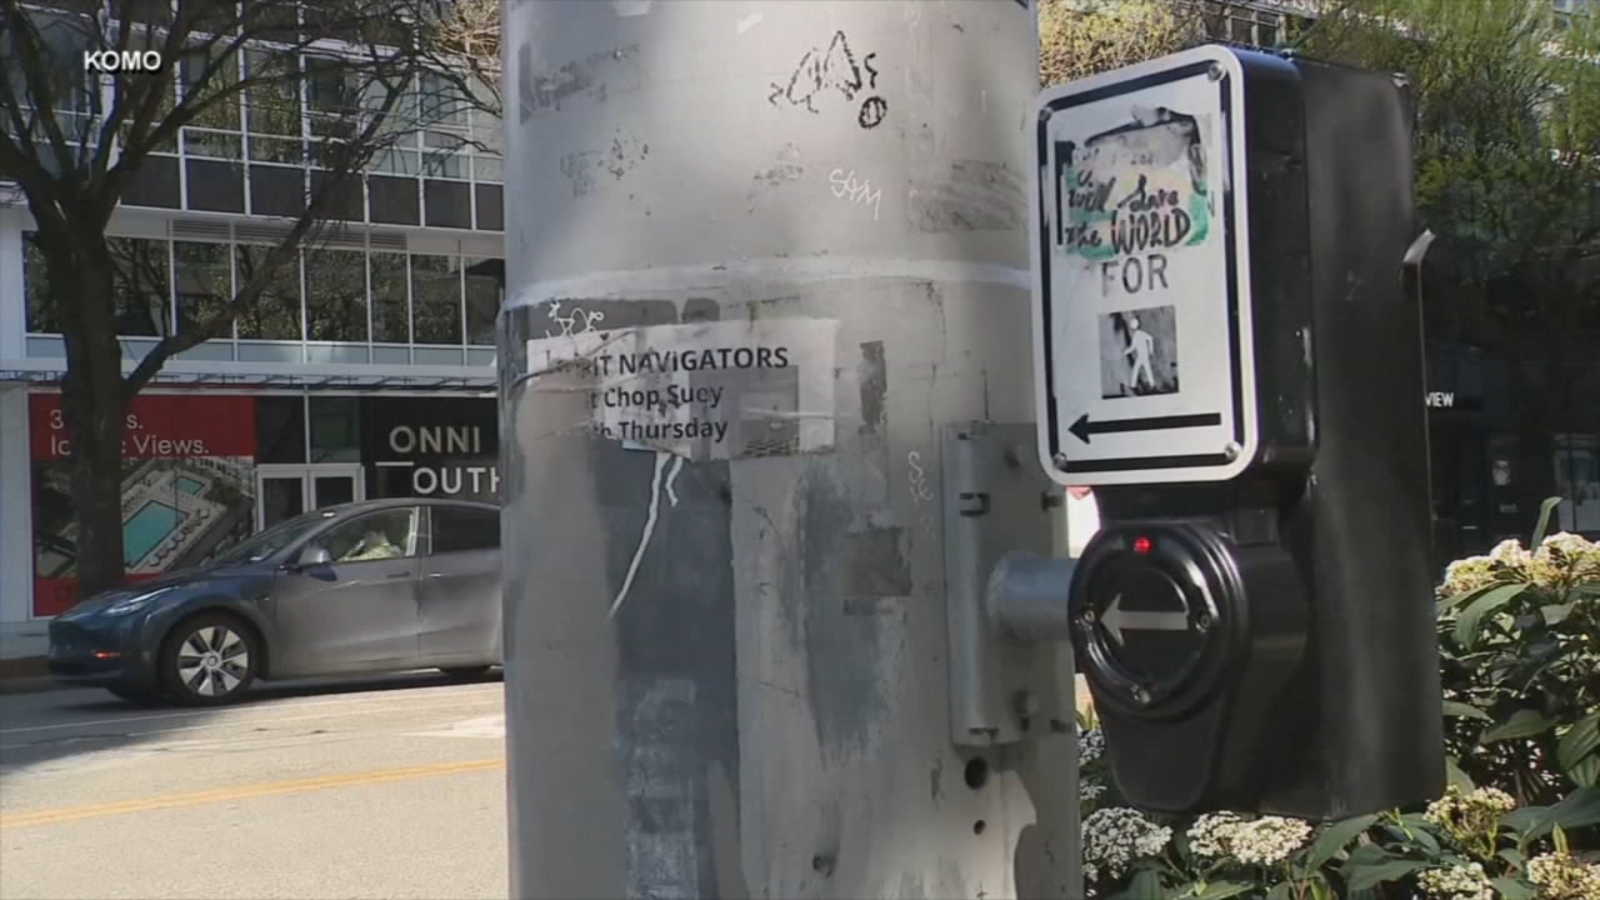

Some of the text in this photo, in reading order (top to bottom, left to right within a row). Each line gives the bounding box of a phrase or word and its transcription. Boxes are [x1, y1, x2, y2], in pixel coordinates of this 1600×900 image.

[1101, 254, 1168, 297] FOR
[604, 386, 661, 411] Chop
[667, 383, 724, 409] Suey
[1425, 392, 1454, 407] VIEW
[389, 425, 481, 454] ONNI
[618, 417, 728, 443] Thursday
[132, 434, 210, 455] Views.
